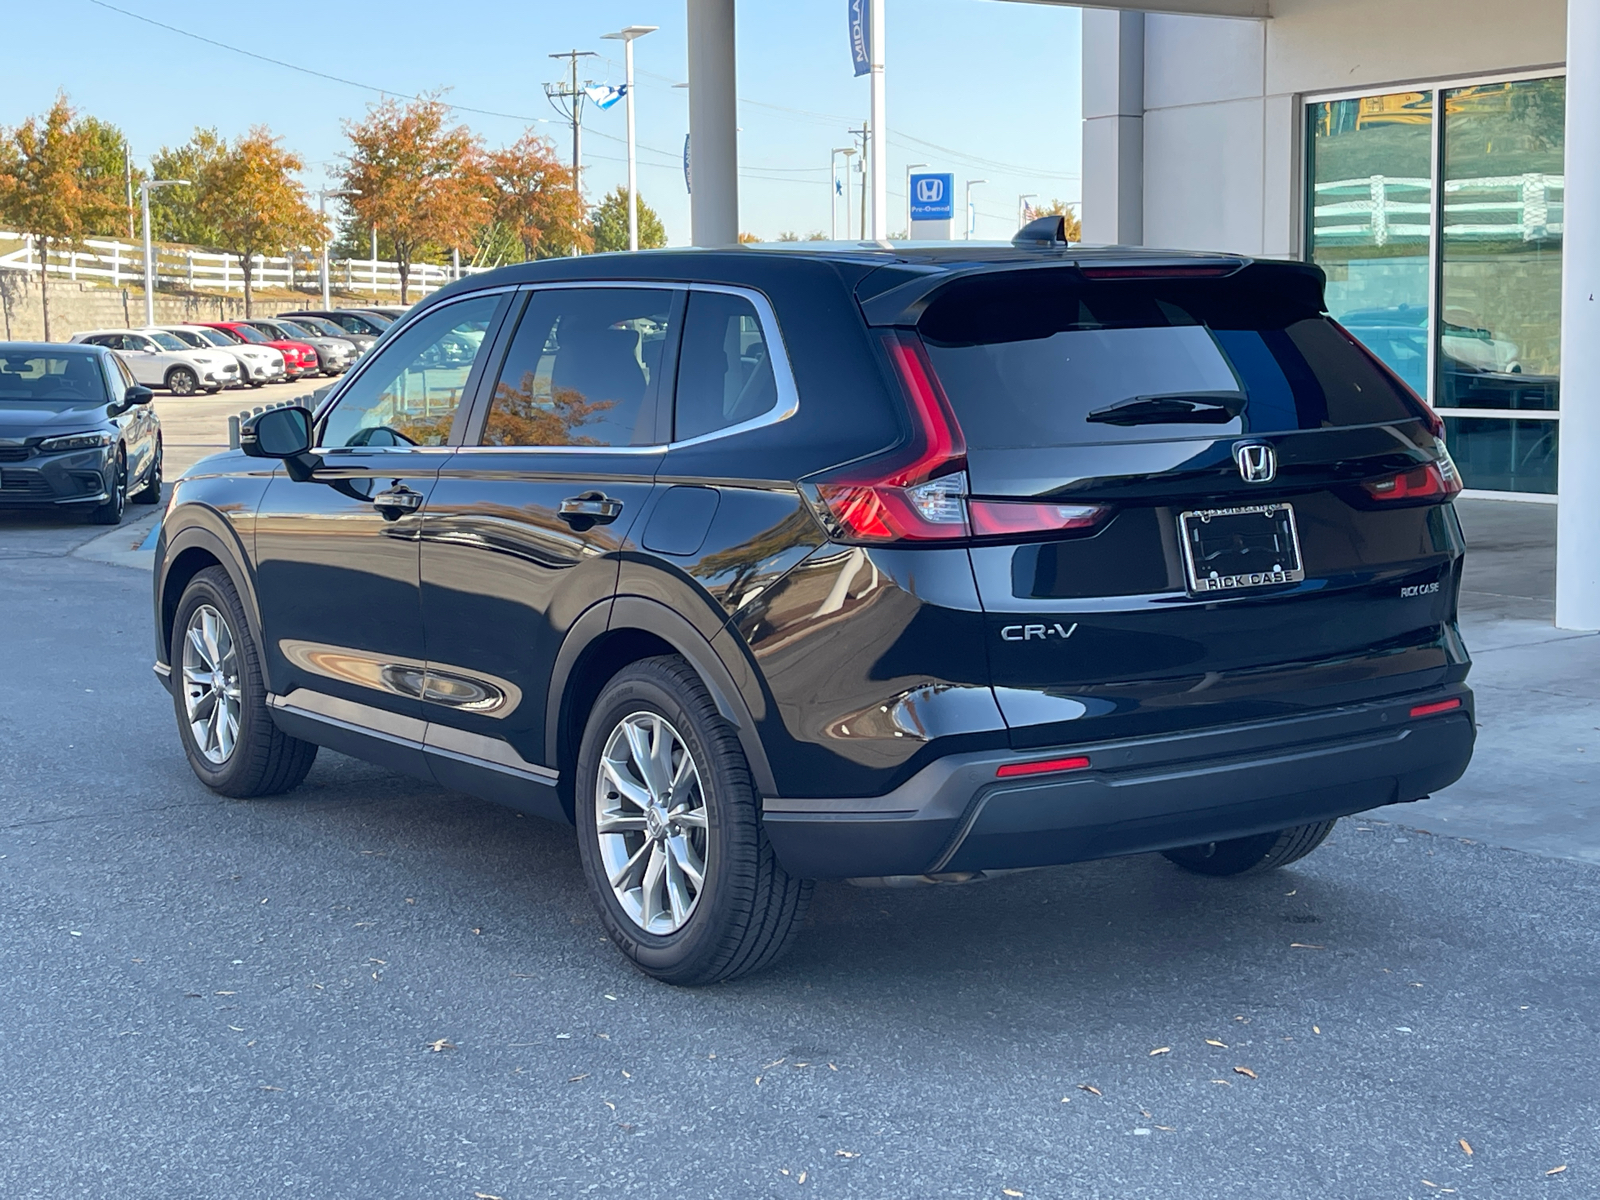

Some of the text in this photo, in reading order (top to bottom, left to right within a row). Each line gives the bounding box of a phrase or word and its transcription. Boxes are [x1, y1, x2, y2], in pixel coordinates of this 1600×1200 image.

[1206, 571, 1293, 590] RICK CASE
[1400, 582, 1439, 598] RICK CASE
[1001, 622, 1078, 640] CR-V
